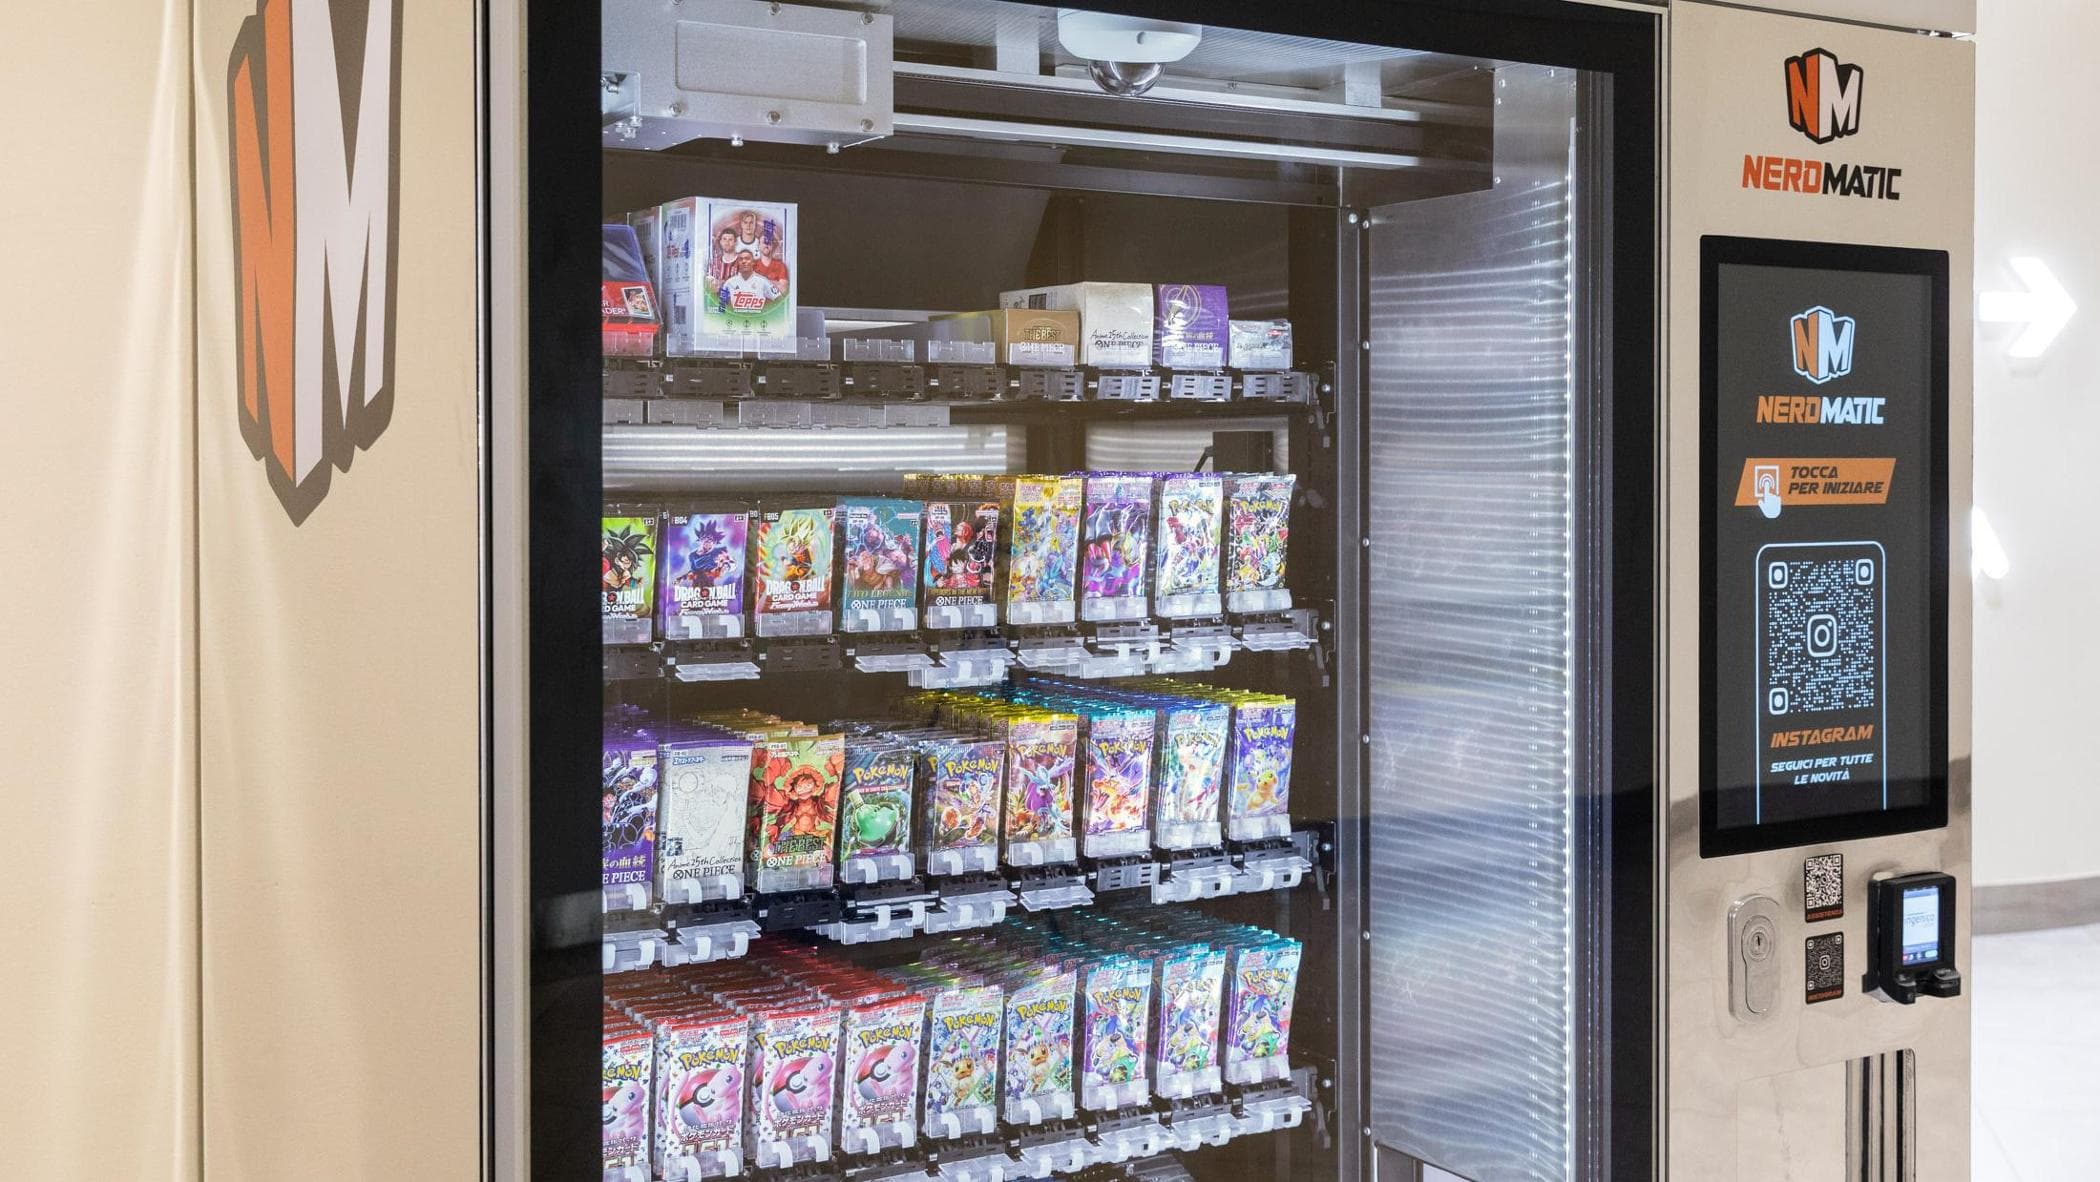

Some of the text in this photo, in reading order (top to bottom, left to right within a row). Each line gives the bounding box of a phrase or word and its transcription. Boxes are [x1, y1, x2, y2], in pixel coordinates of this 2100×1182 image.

[1785, 48, 1863, 144] NM
[1742, 154, 1902, 200] NERDMATIC
[1790, 305, 1855, 384] NM
[1756, 395, 1886, 425] NERDMATIC
[1790, 465, 1839, 480] TOCCA
[1788, 480, 1885, 496] PER INIZIARE
[851, 598, 907, 610] ONE PIECE
[935, 595, 984, 606] ONE PIECE
[1769, 724, 1875, 749] INSTAGRAM
[1770, 752, 1873, 773] SEGUICI PER TUTTE
[1794, 768, 1850, 785] LE NOVITÀ
[766, 855, 793, 868] ONE
[612, 870, 646, 883] PIECE
[672, 865, 735, 880] ONE PIECE
